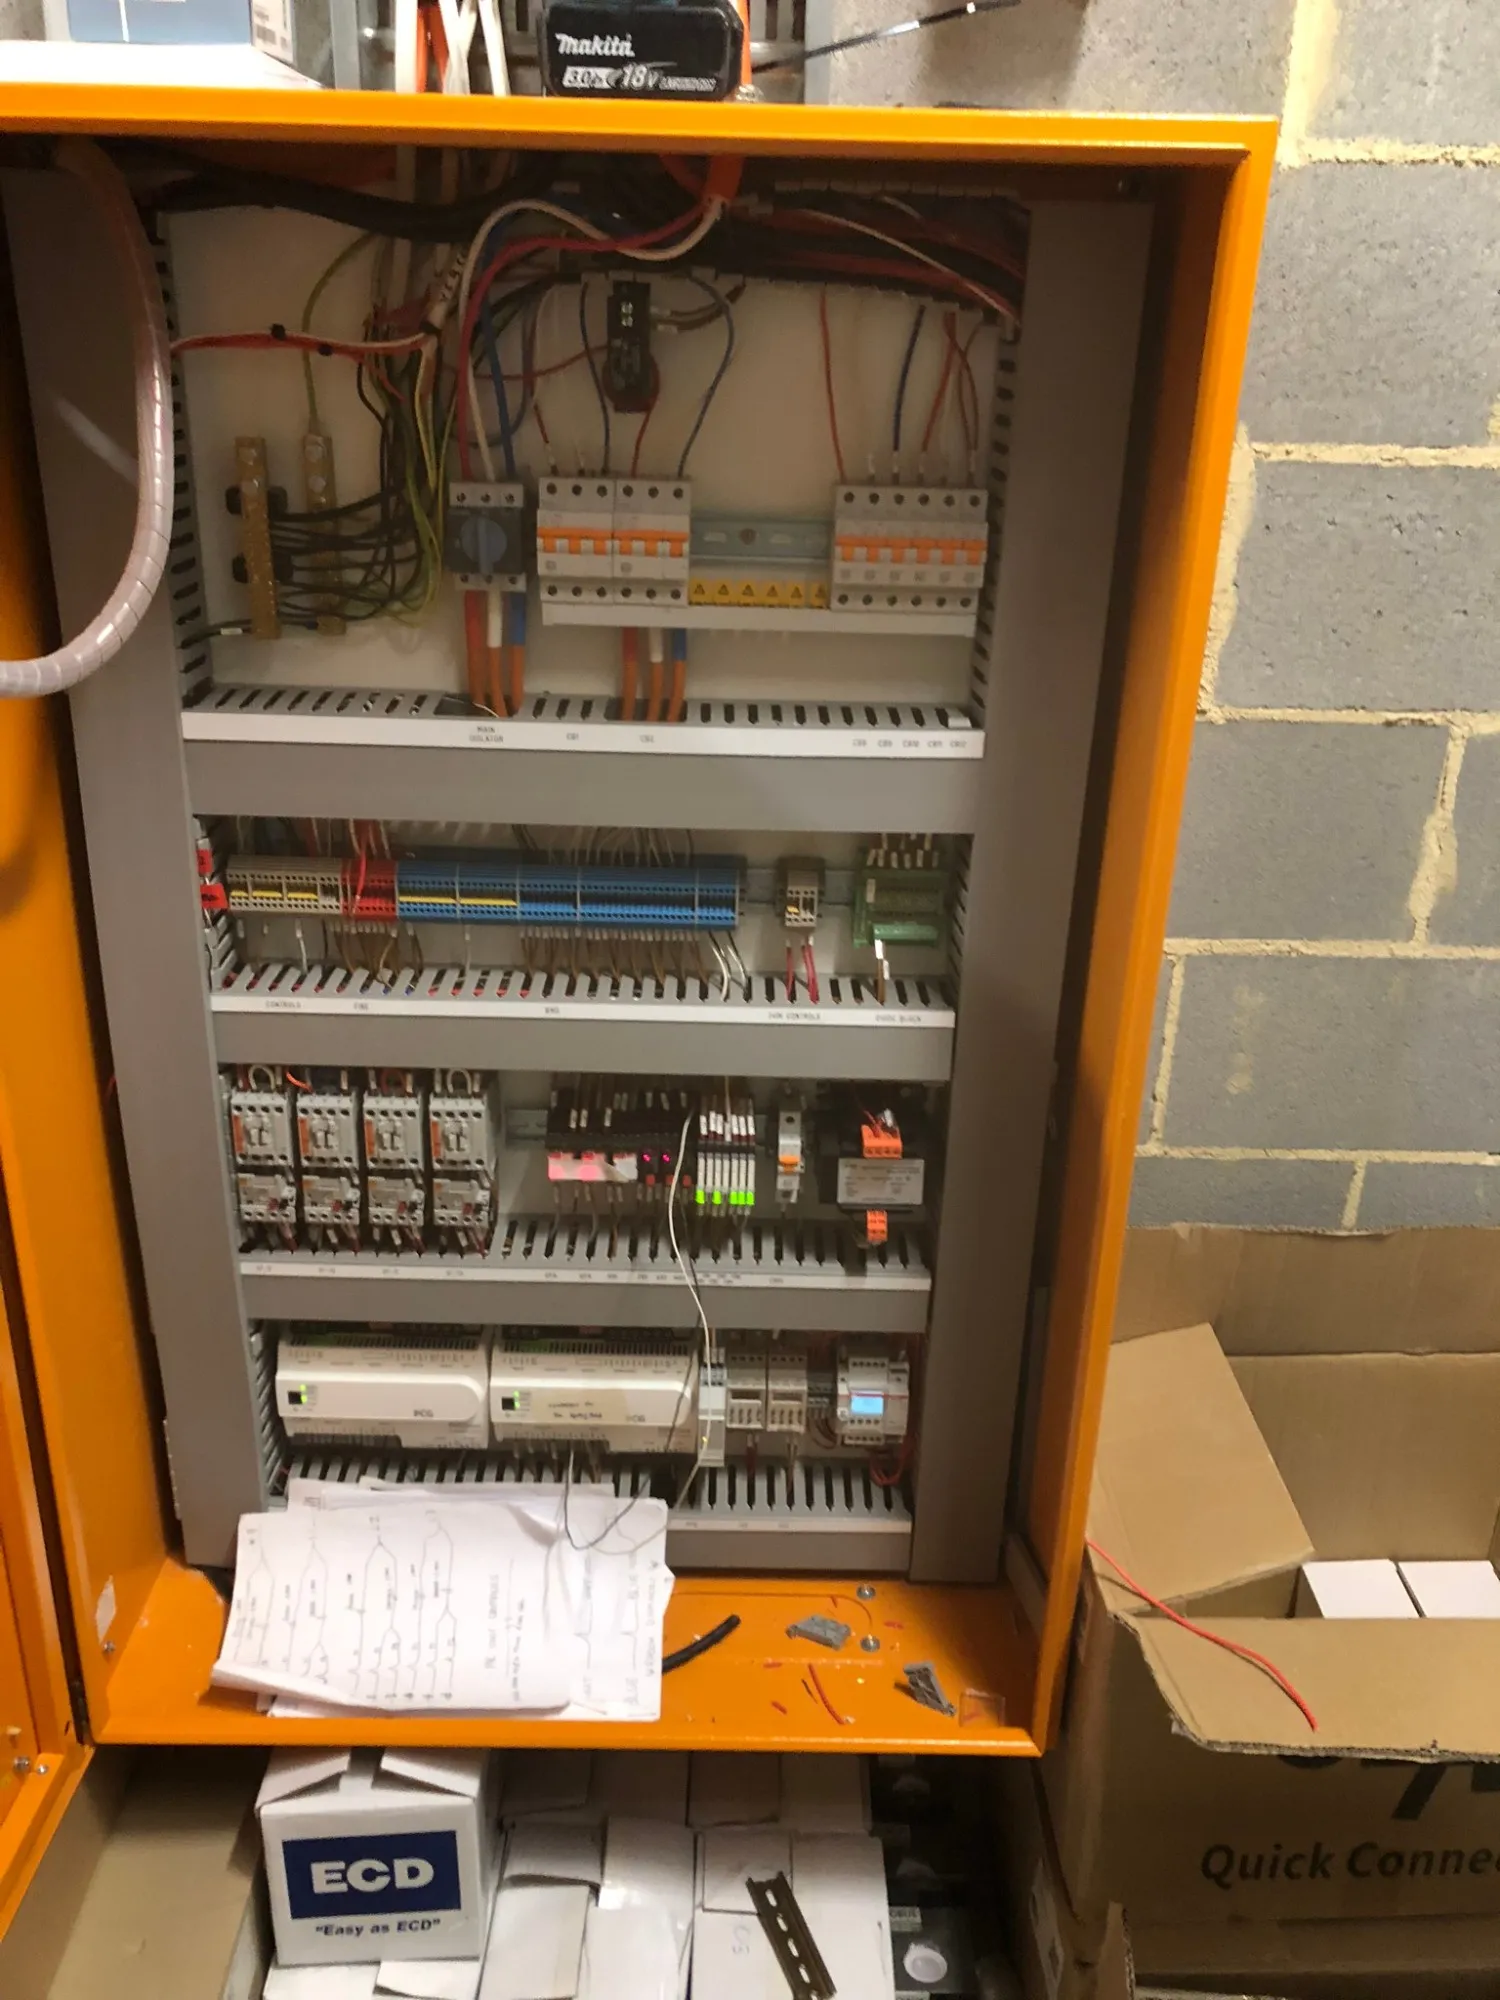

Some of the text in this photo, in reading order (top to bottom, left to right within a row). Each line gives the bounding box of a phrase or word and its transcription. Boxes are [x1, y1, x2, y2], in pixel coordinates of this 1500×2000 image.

[311, 1858, 434, 1894] ECD
[1200, 1843, 1335, 1890] Quick
[370, 1923, 390, 1934] as
